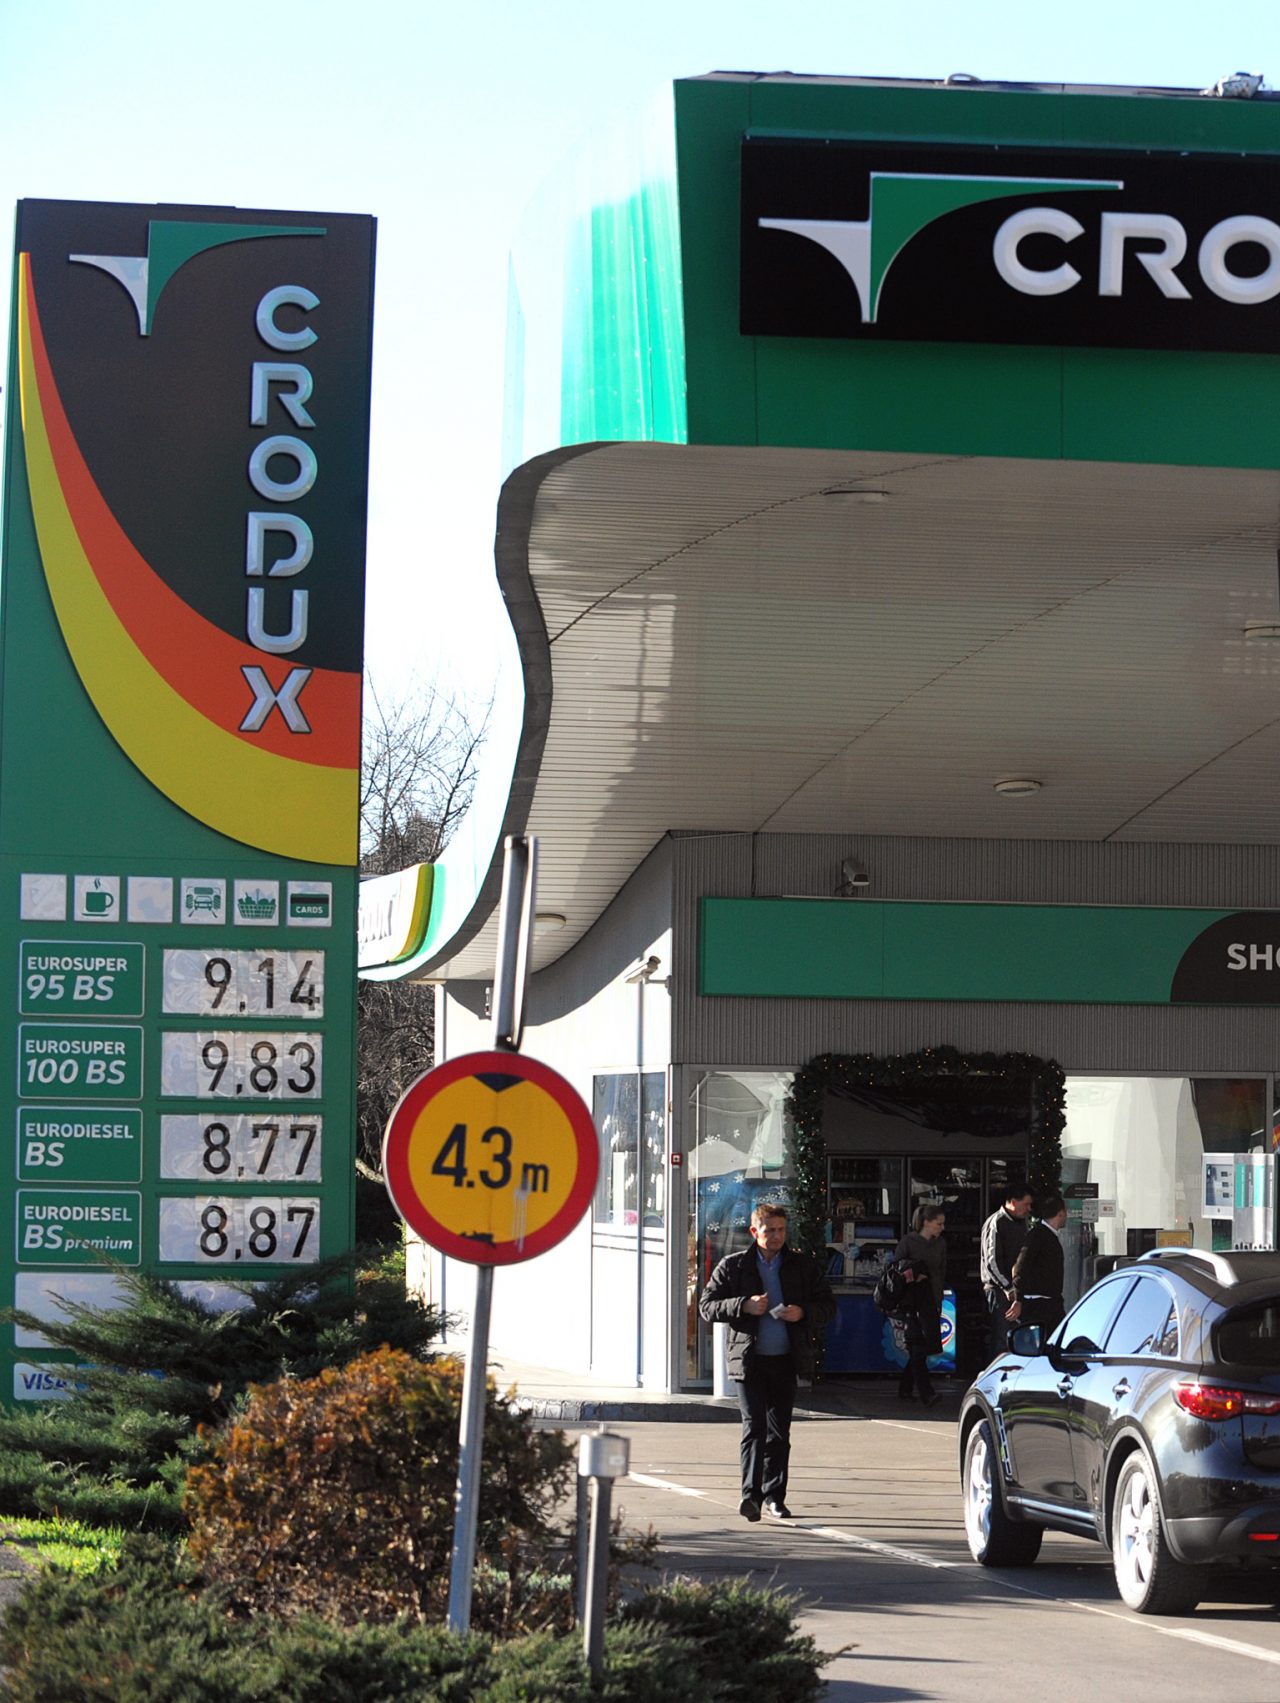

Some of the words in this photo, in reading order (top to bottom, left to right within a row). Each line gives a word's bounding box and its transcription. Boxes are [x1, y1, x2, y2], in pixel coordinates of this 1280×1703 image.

[238, 284, 321, 734] CRODUX
[295, 906, 324, 914] CARDS
[27, 956, 128, 972] EUROSUPER
[26, 974, 65, 1001] 95
[73, 975, 115, 1001] BS
[204, 957, 321, 1012] 9,14
[25, 1039, 126, 1055] EUROSUPER
[26, 1059, 79, 1084] 100
[86, 1060, 126, 1085] BS
[202, 1039, 316, 1095] 9,83
[25, 1123, 134, 1139] EURODIESEL
[24, 1141, 66, 1167] BS
[202, 1122, 317, 1177] 8,77
[24, 1205, 133, 1222] EURODIESEL
[23, 1224, 64, 1250] BS
[64, 1235, 133, 1252] premium
[200, 1205, 315, 1260] 8,87
